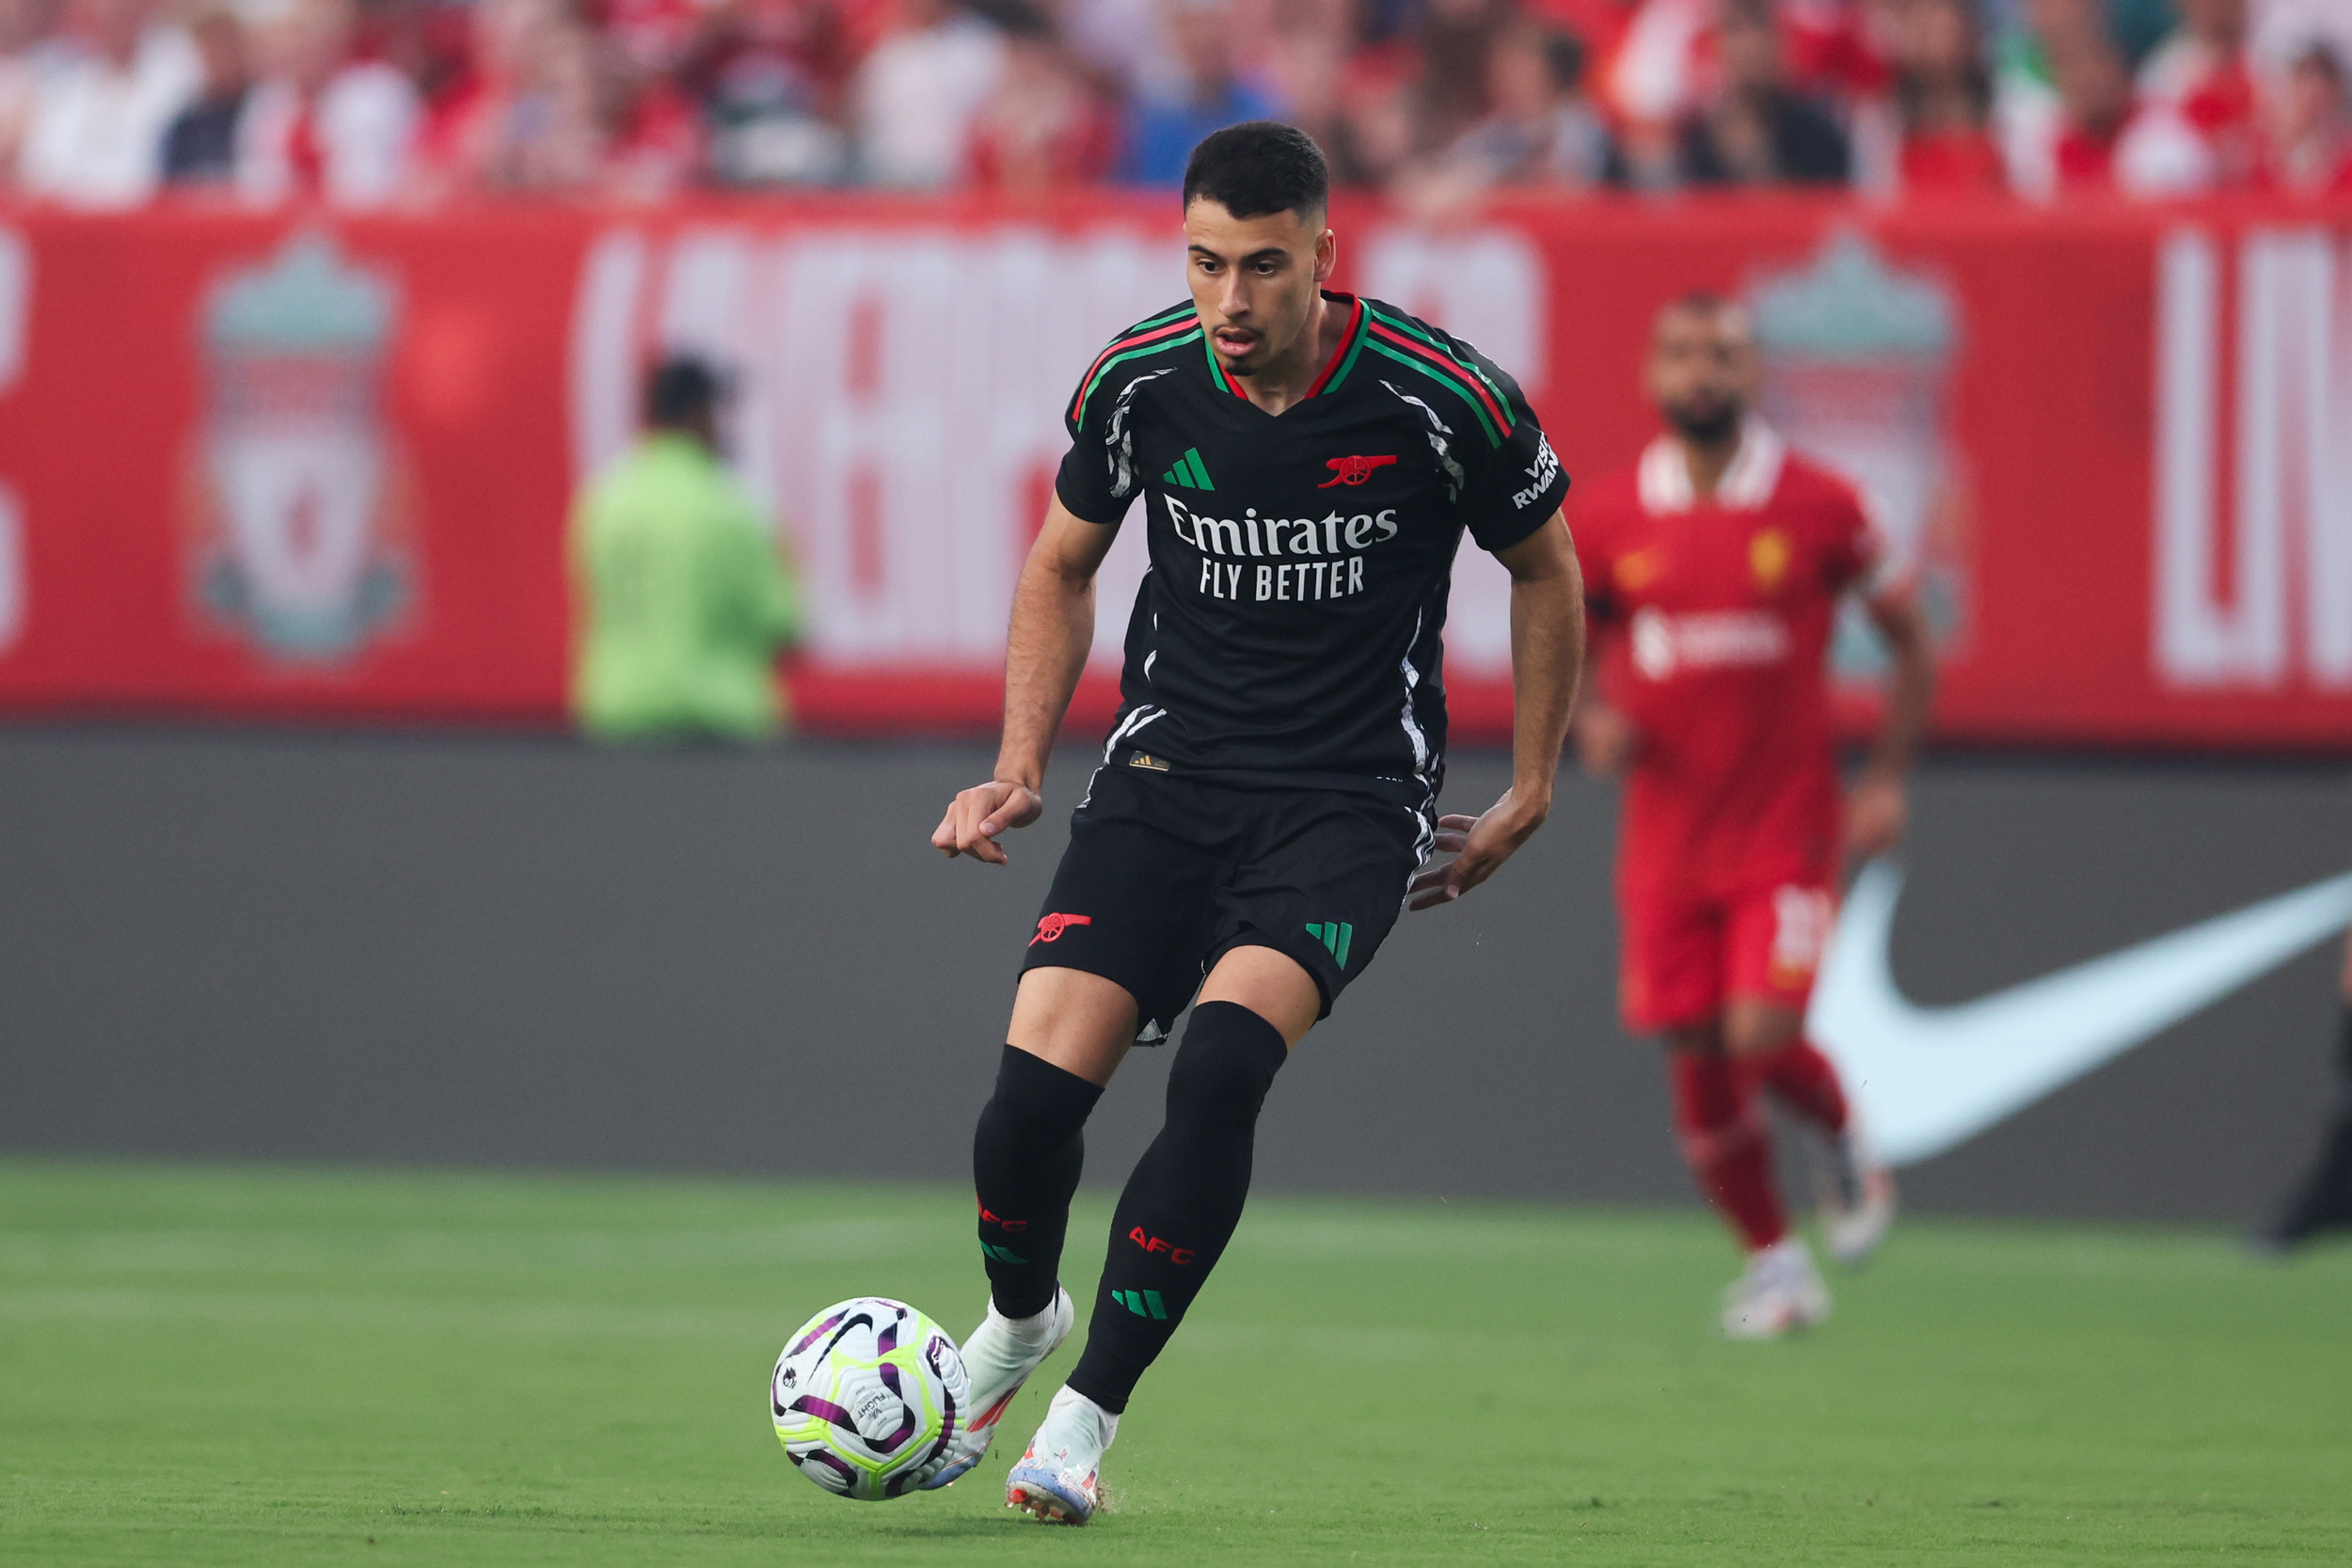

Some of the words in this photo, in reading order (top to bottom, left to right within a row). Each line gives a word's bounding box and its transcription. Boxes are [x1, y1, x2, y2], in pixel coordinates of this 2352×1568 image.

[1512, 444, 1559, 510] RWAN
[1163, 492, 1398, 557] Emirates
[1200, 556, 1242, 600] FLY
[1255, 555, 1364, 602] BETTER
[1129, 1226, 1195, 1265] AFC
[857, 1392, 886, 1418] FLIGHT
